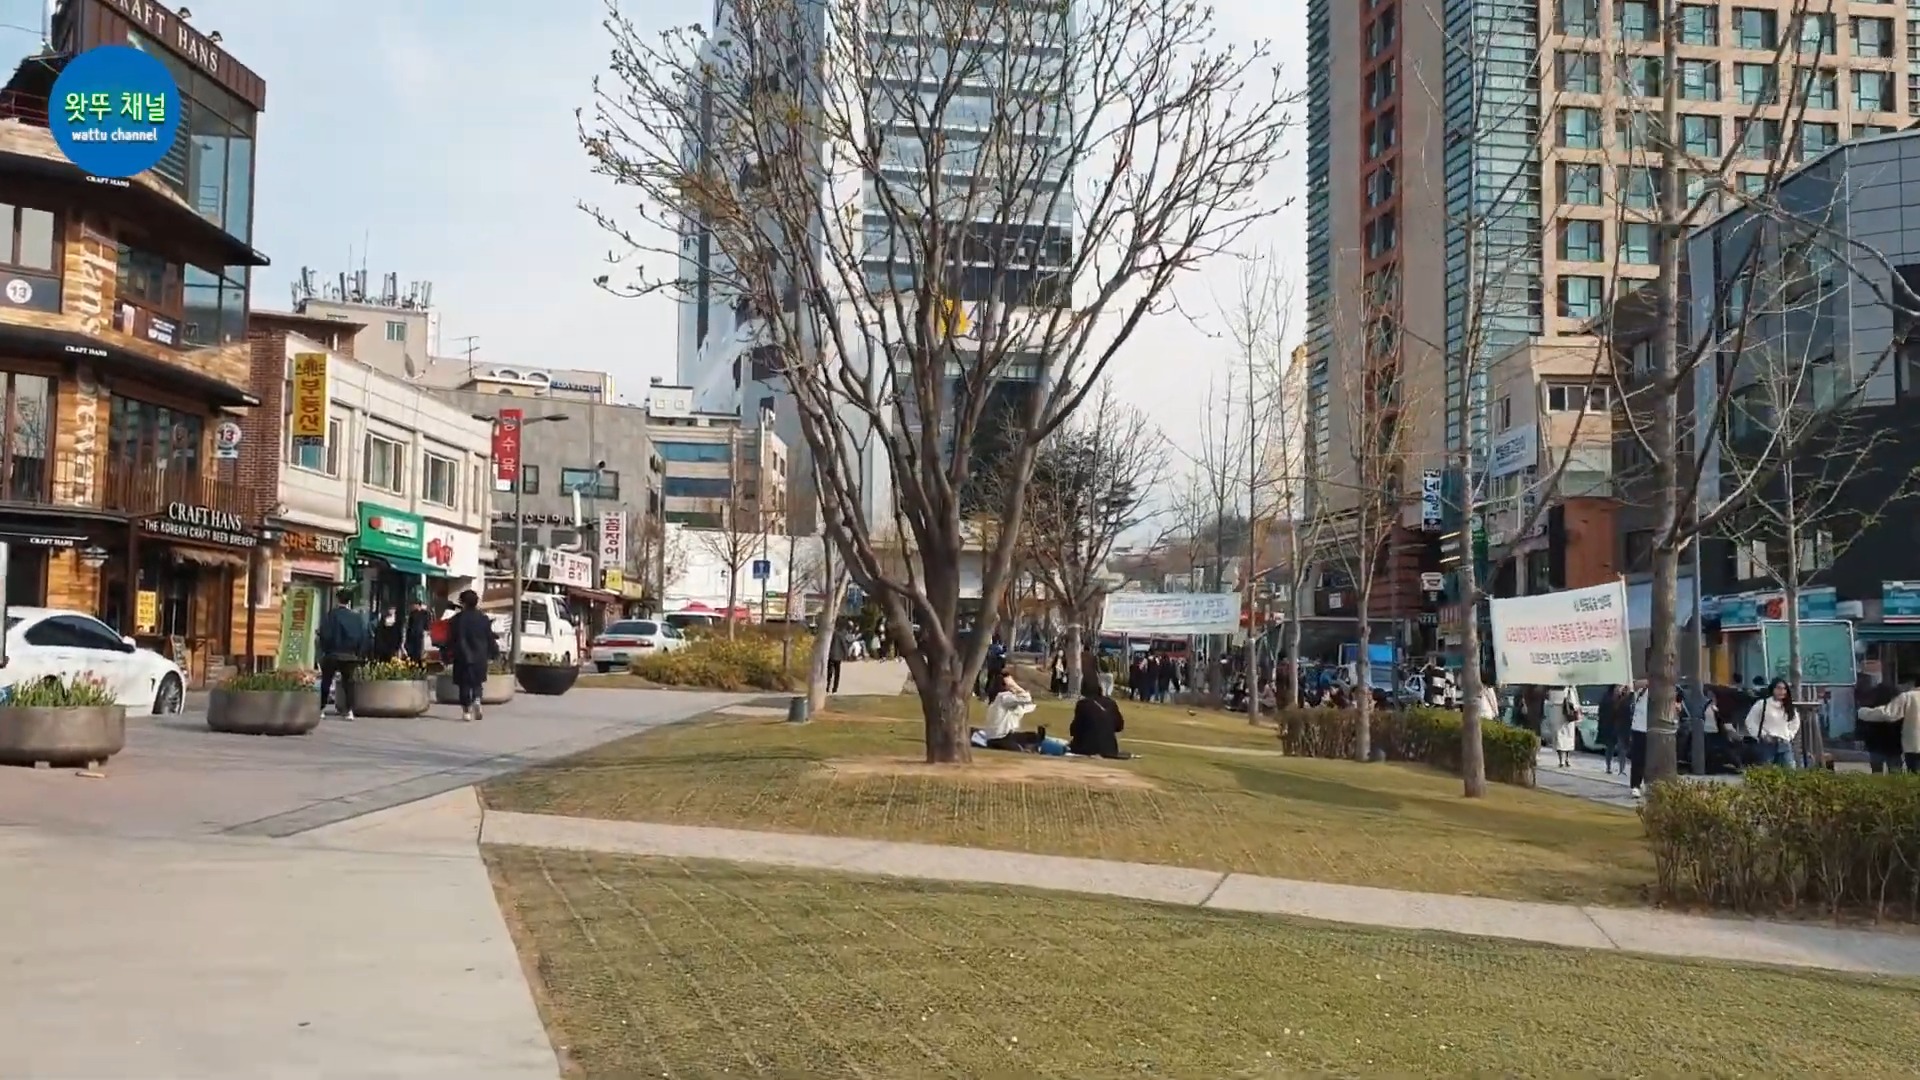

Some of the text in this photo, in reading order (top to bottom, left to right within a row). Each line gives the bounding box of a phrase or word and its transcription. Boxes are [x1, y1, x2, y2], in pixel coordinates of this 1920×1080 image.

[112, 0, 218, 72] RAFT HANS
[86, 176, 109, 185] CRAFT
[65, 345, 88, 354] CRAFT
[217, 429, 234, 442] 13
[169, 501, 242, 532] CRAFT HANS
[145, 519, 158, 532] THE
[161, 521, 188, 537] KOREAN
[189, 527, 211, 539] CRAFT
[212, 530, 229, 543] BEER
[30, 537, 54, 546] CRAFT
